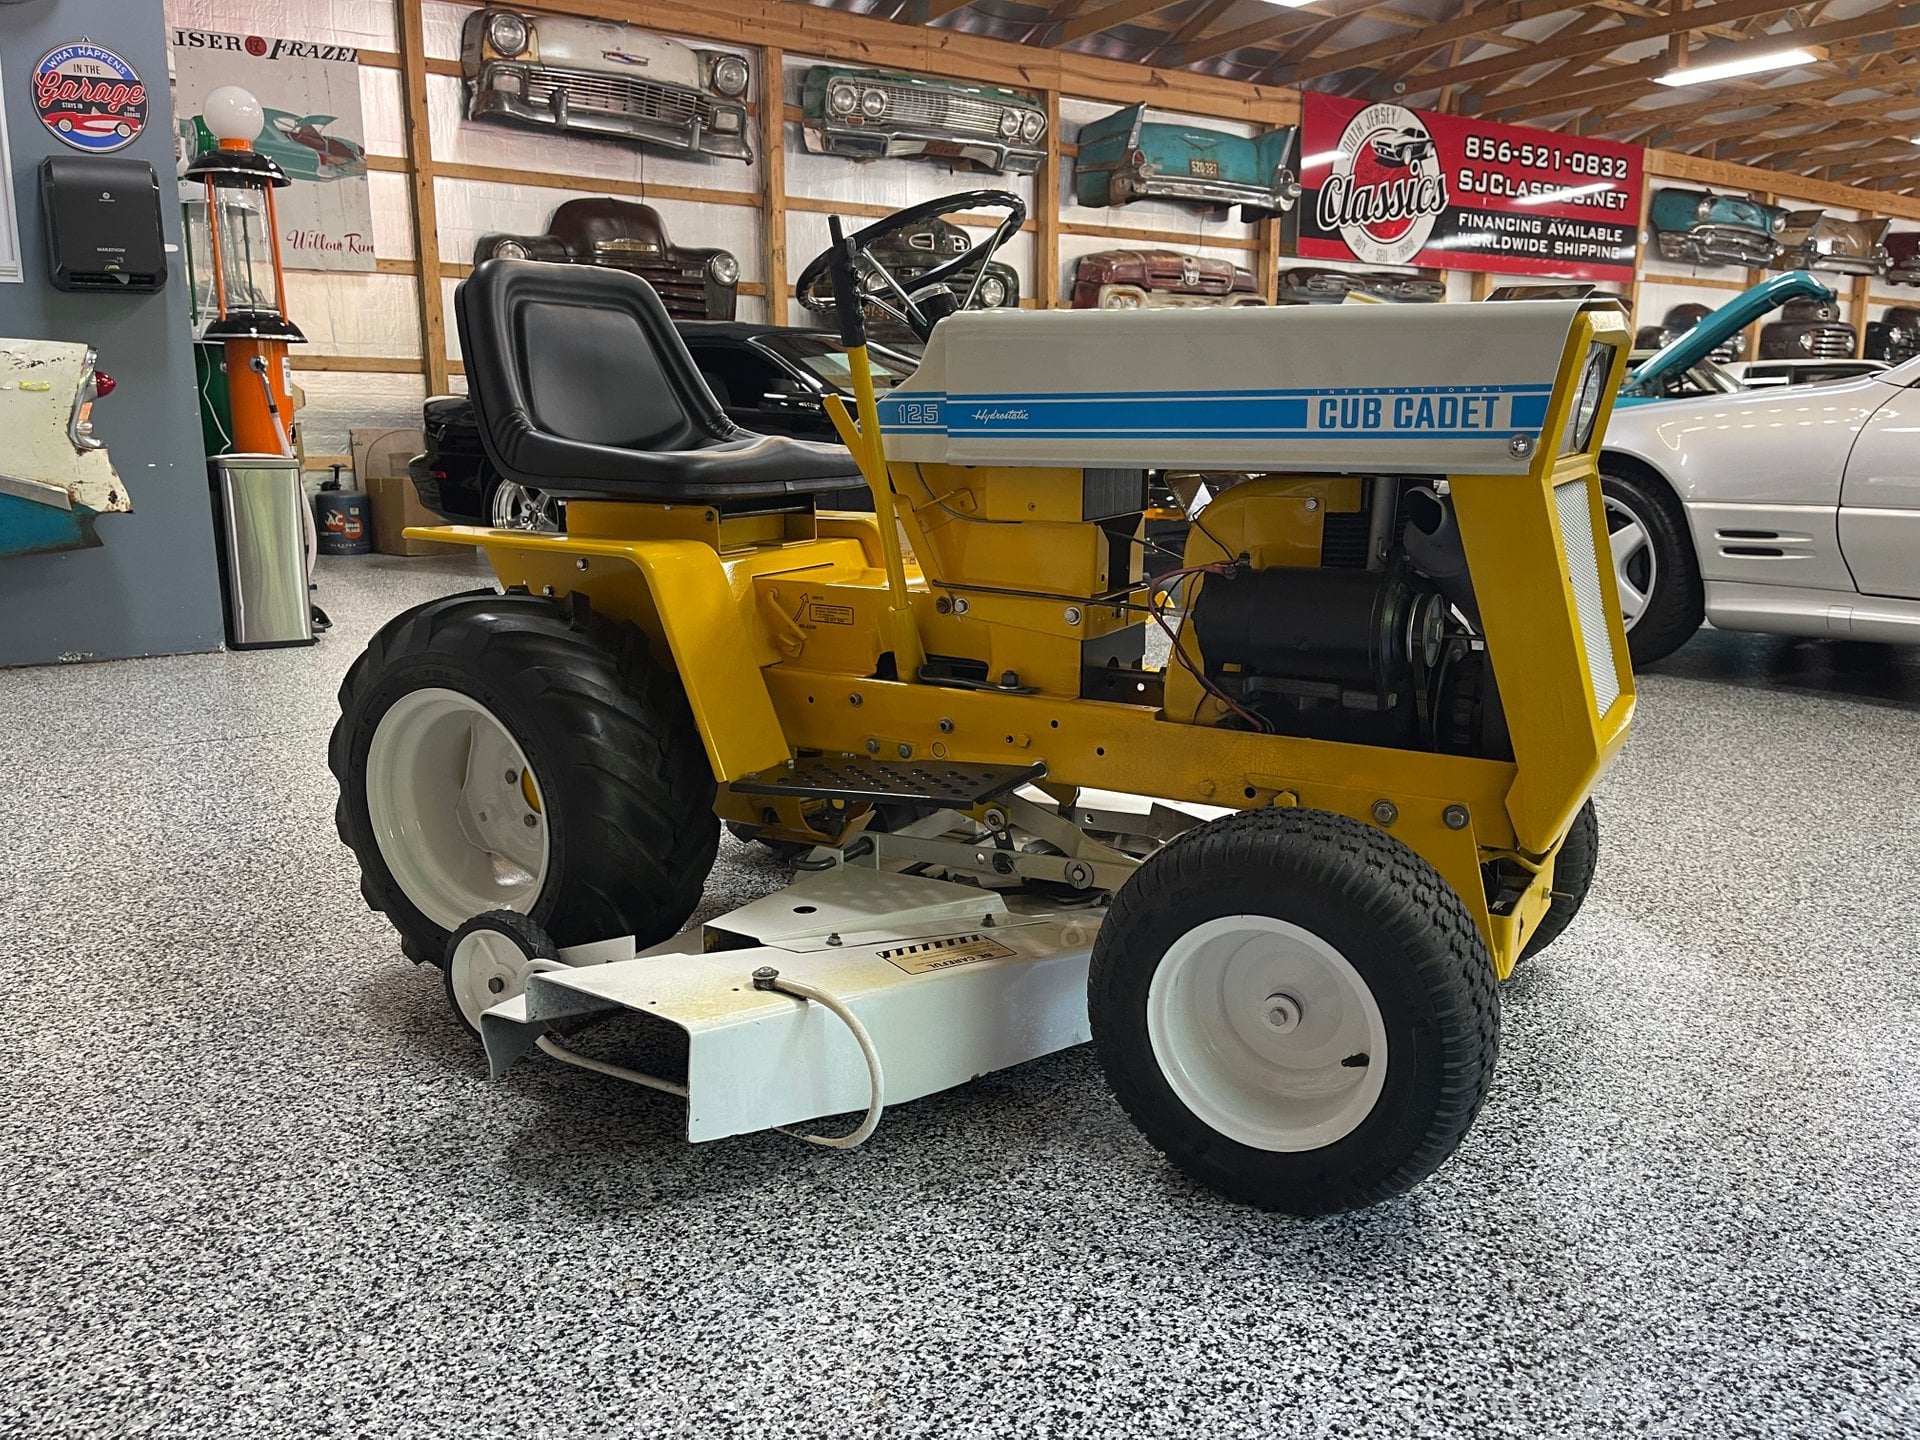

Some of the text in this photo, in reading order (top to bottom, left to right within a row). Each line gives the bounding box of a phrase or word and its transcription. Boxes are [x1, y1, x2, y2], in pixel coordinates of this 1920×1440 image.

[173, 31, 242, 51] ISER
[47, 48, 127, 75] WHAT HAPPENS
[73, 64, 101, 75] IN THE
[34, 70, 145, 113] Garage
[1366, 106, 1397, 130] JERSEY
[1465, 136, 1628, 179] 856-521-0832
[1316, 158, 1450, 231] Classics
[1458, 212, 1623, 243] FINANCING AVAILABLE
[286, 229, 374, 255] Willow Run
[1457, 231, 1621, 260] WORLDWIDE SHIPPING
[1317, 386, 1504, 395] INTERNATIONAL
[898, 403, 939, 424] 125
[971, 408, 1029, 424] Hydrostatic
[1318, 395, 1500, 429] CUB CADET
[926, 956, 976, 969] CAREFUL
[978, 952, 994, 960] BE
